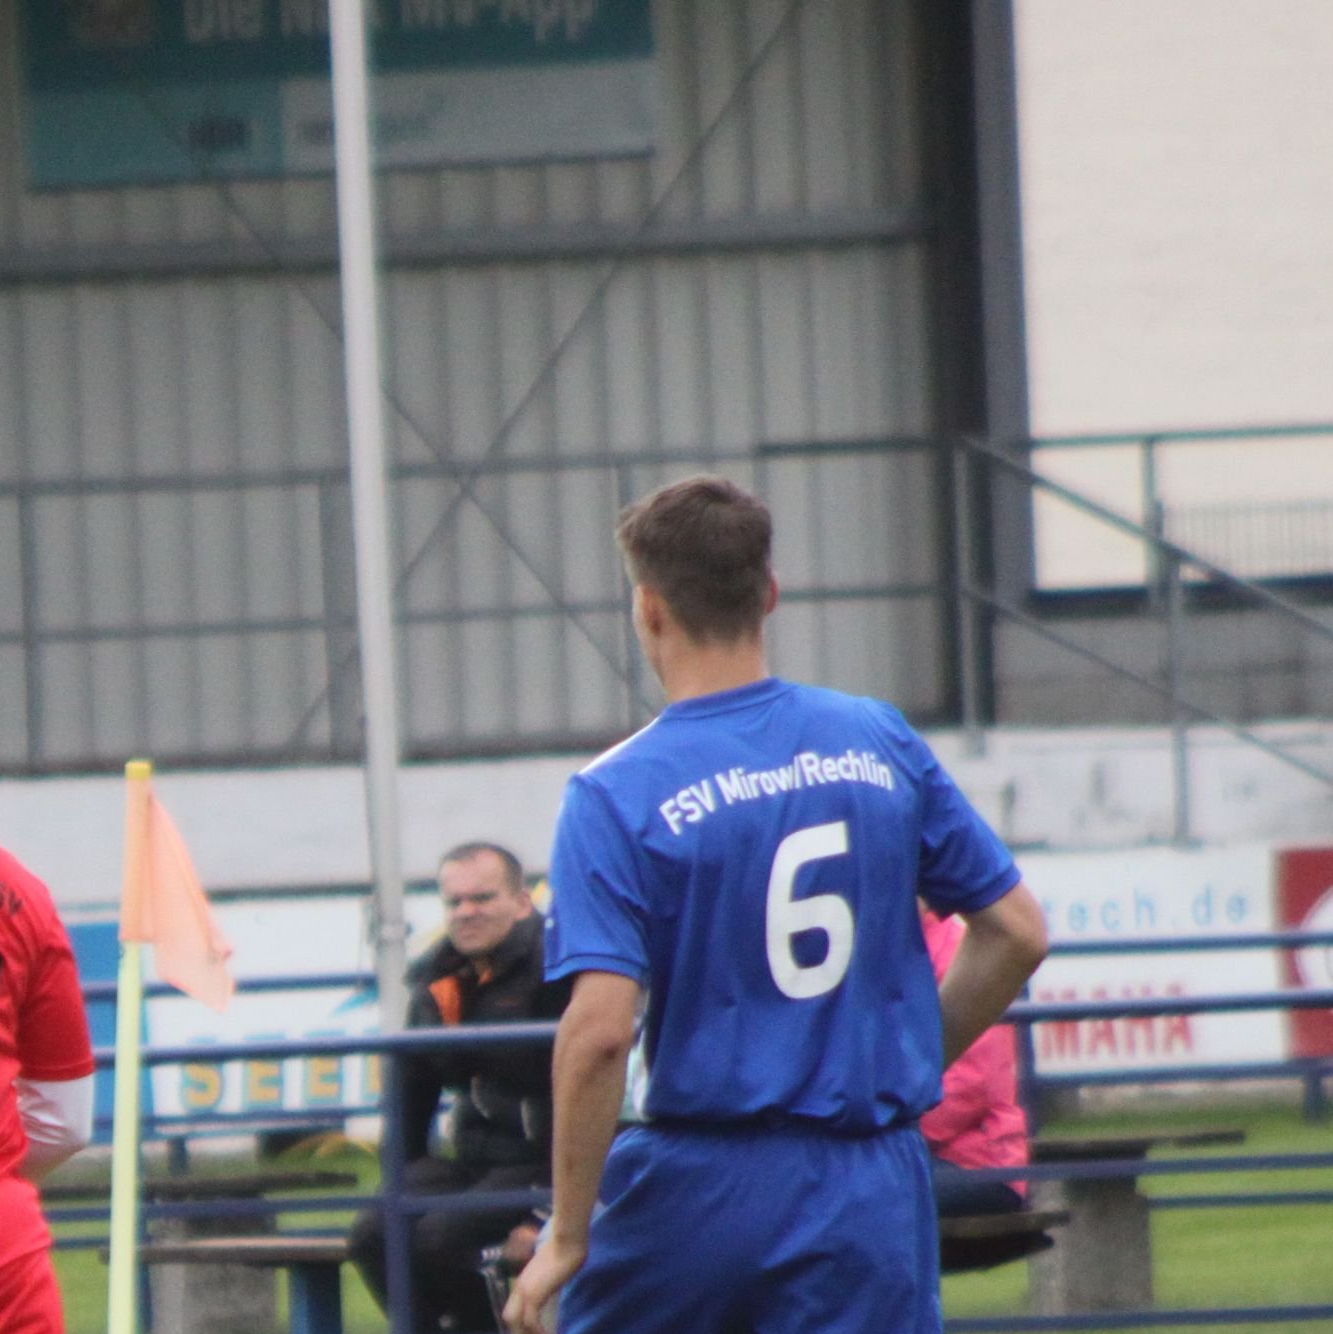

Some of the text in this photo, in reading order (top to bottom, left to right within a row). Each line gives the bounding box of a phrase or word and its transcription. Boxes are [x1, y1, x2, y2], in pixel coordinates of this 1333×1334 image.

[658, 750, 895, 836] FSV Mirow/Rechlin
[765, 820, 855, 1000] 6
